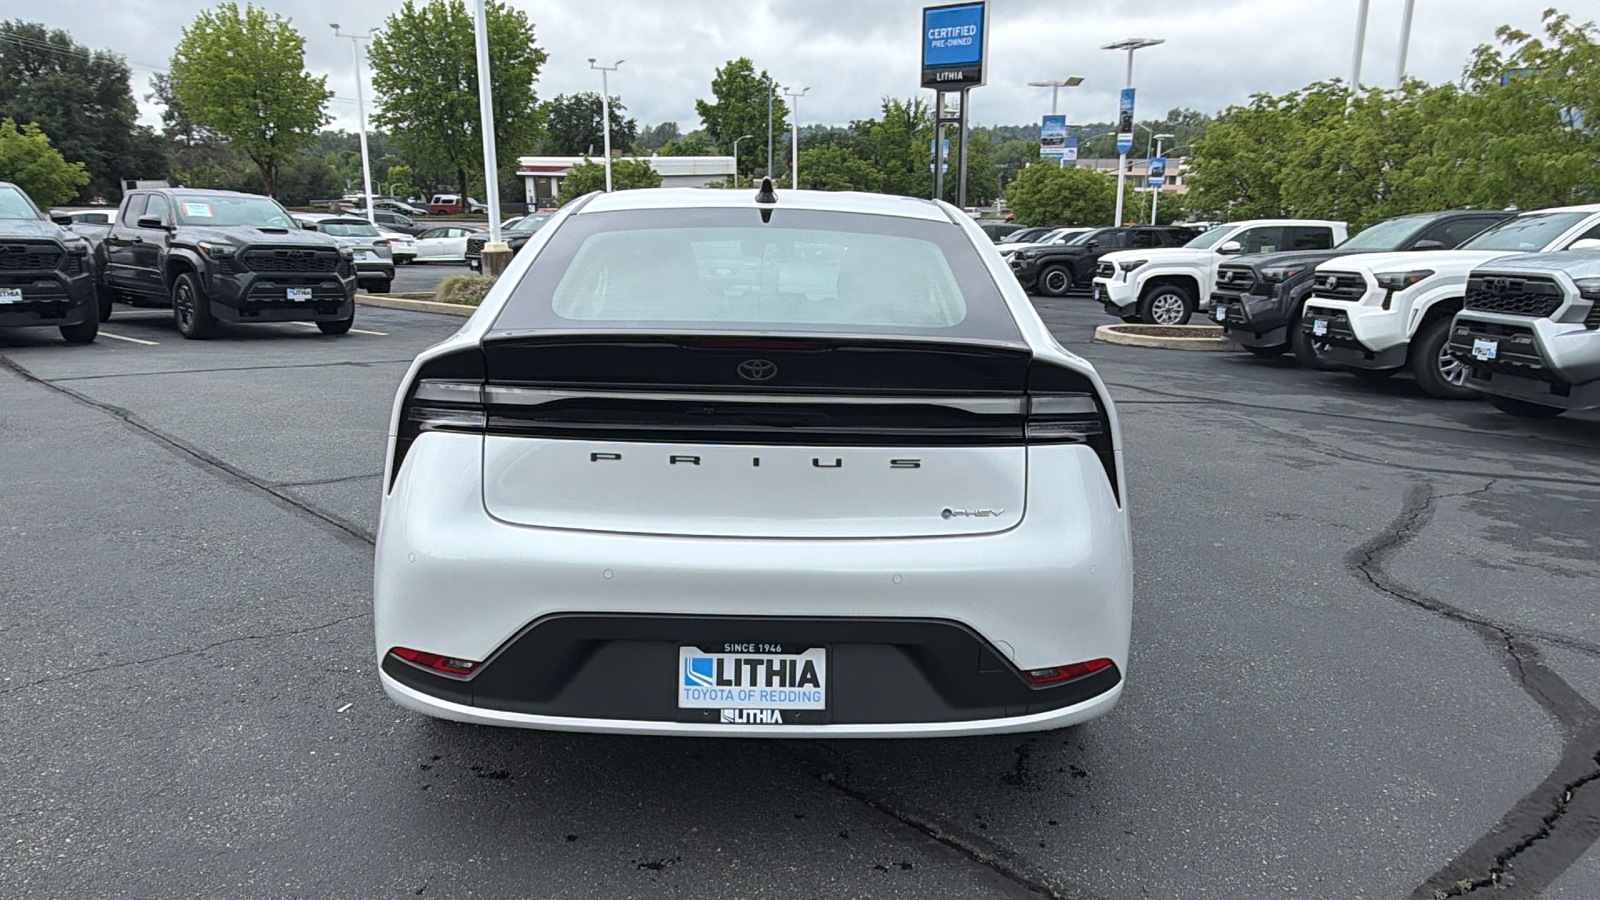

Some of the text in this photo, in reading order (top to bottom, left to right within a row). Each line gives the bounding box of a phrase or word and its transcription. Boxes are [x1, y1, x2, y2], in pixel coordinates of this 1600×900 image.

[928, 25, 977, 39] CERTIFIED
[931, 37, 972, 48] PRE-OWNED
[936, 71, 963, 81] LITHIA
[590, 452, 921, 469] PRIUS
[952, 508, 1005, 518] PHEV
[724, 643, 782, 653] SINCE 1946
[716, 658, 821, 688] LITHIA
[684, 688, 821, 703] TOYOTA OF REDDING
[733, 709, 783, 724] LITHIA
